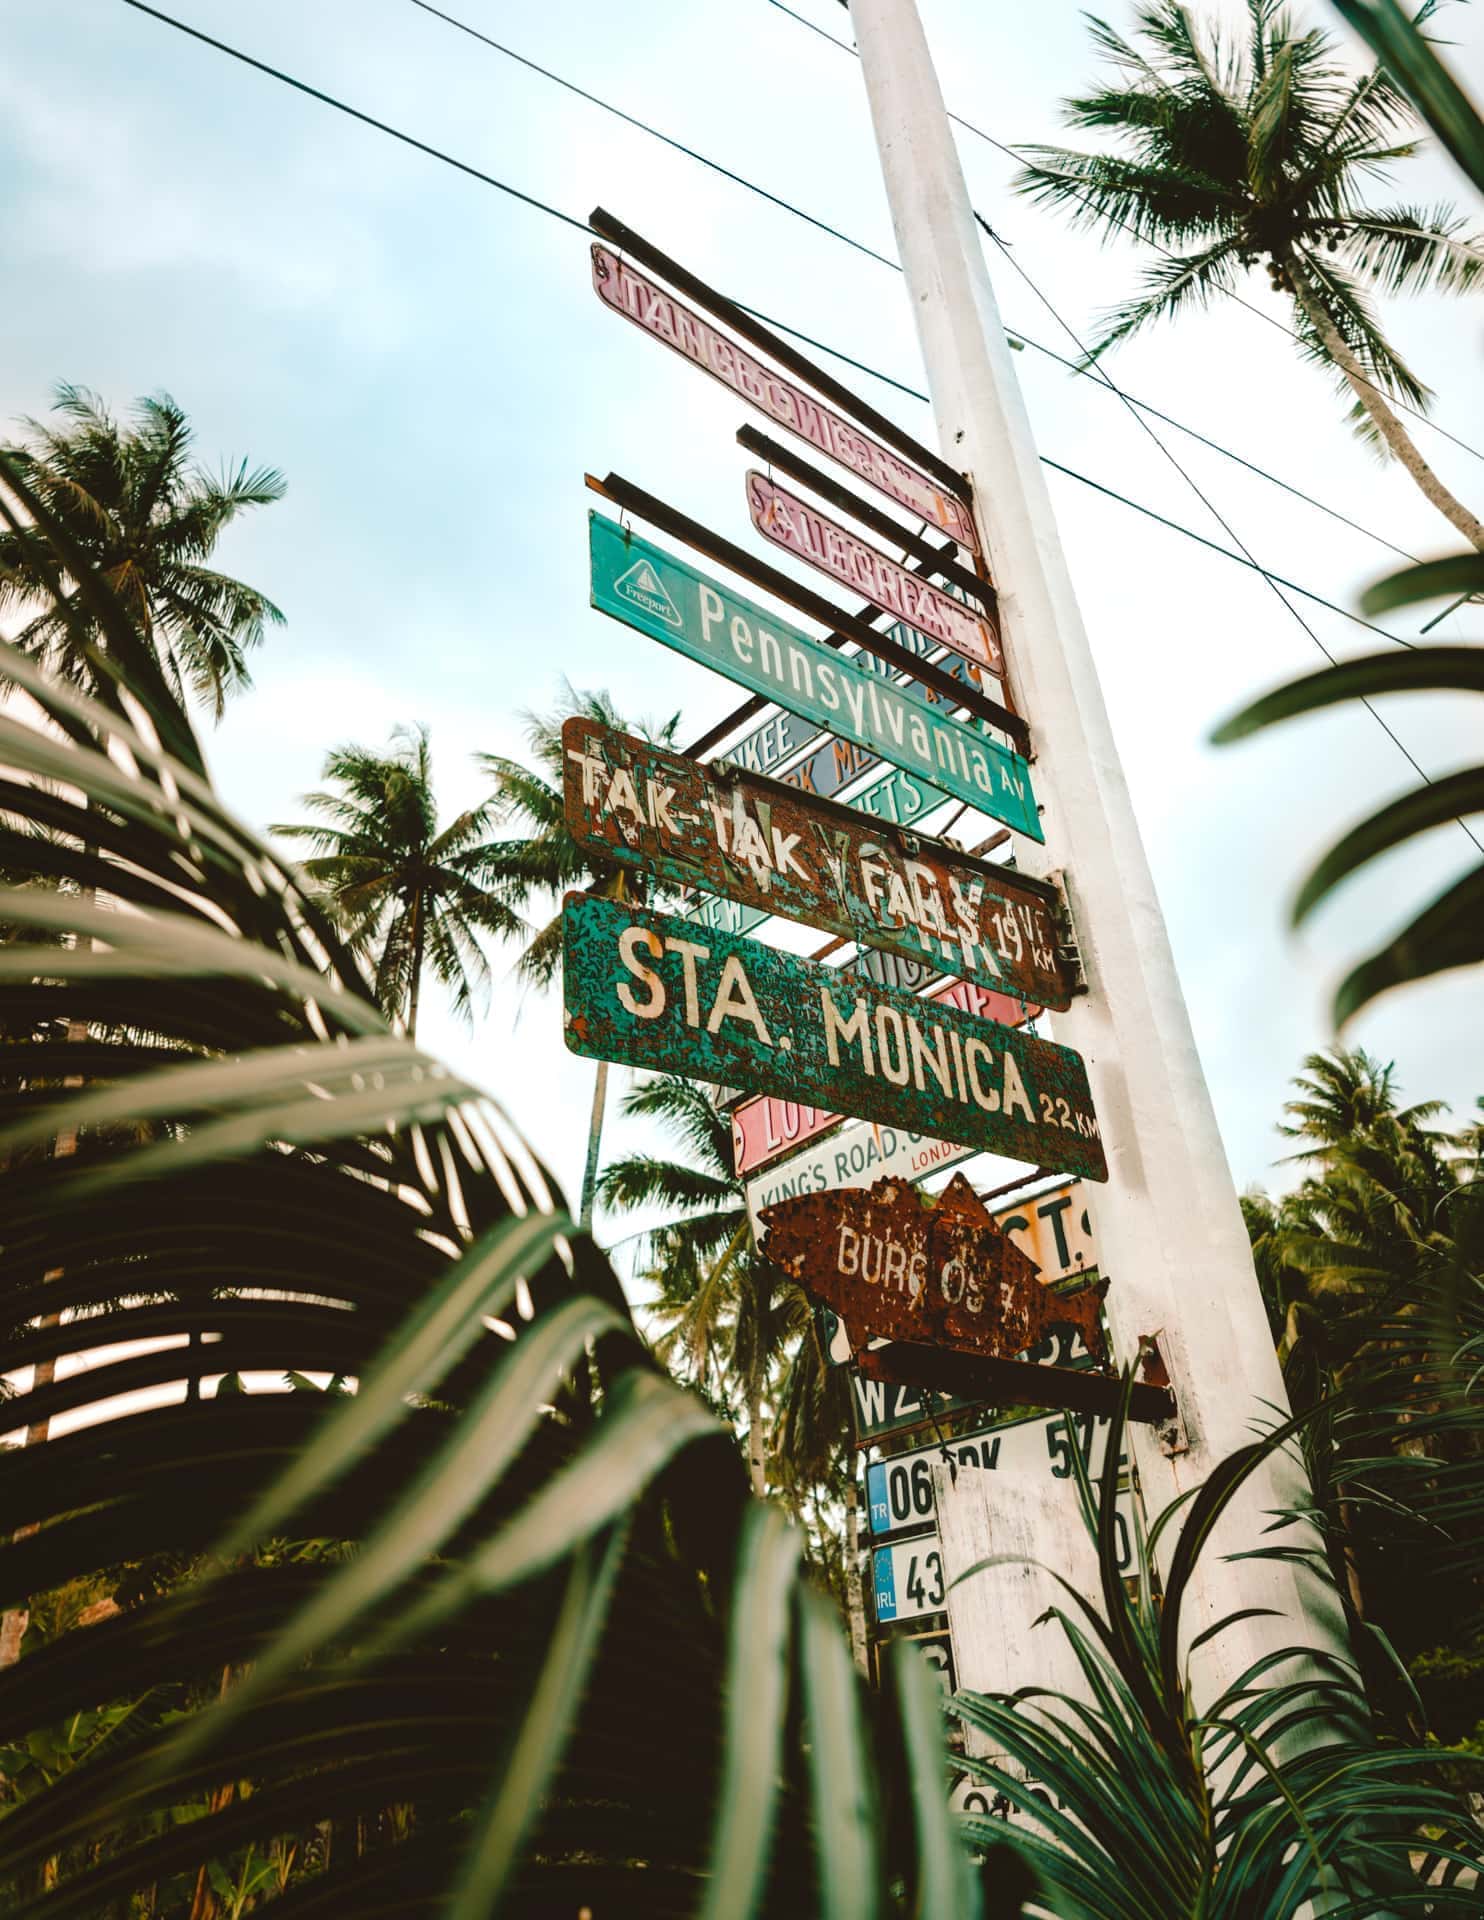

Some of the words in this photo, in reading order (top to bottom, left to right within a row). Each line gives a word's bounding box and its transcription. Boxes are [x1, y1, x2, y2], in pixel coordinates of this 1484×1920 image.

[625, 583, 674, 616] Freeport
[699, 583, 993, 797] Pennsylvania
[860, 860, 981, 946] FALLS
[1031, 943, 1056, 973] KM
[616, 926, 793, 1050] STA.
[820, 987, 1036, 1123] MONICA
[1039, 1093, 1075, 1132] 22
[1075, 1111, 1100, 1139] KM
[761, 1163, 827, 1208] KING'S
[872, 1503, 888, 1521] TR
[890, 1459, 932, 1521] 06
[877, 1591, 896, 1609] IRL
[907, 1551, 945, 1608] 43
